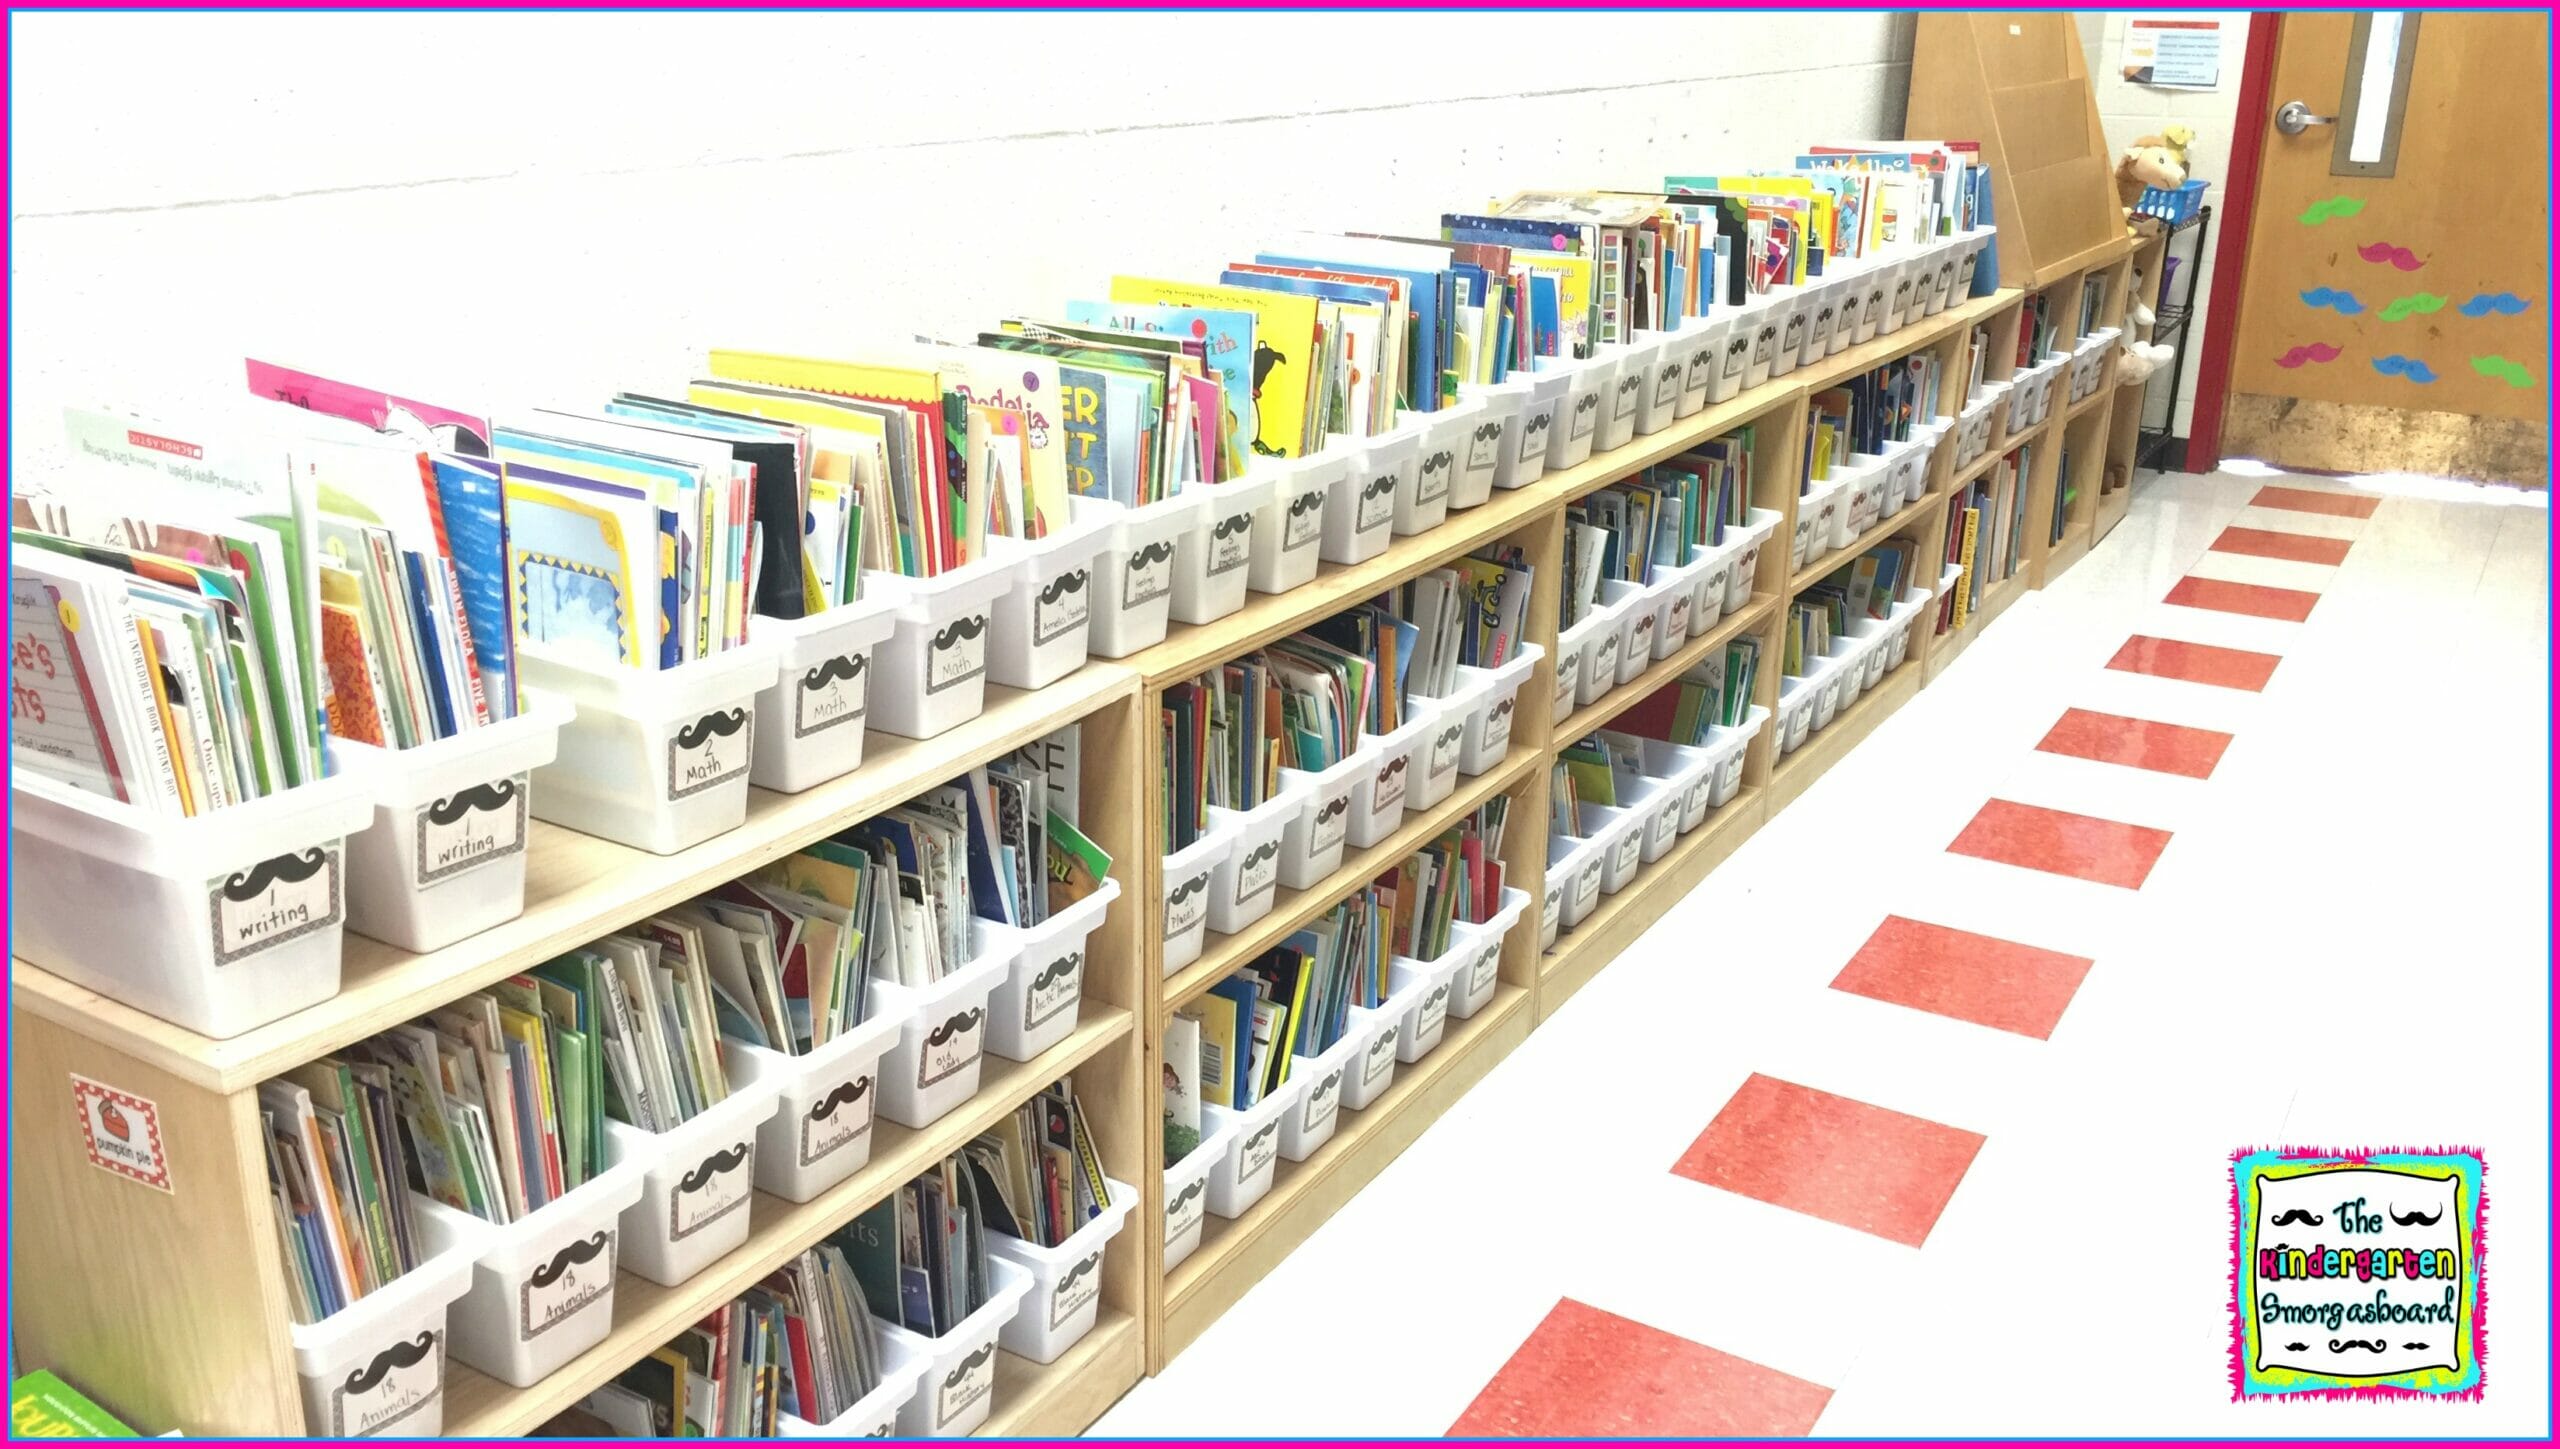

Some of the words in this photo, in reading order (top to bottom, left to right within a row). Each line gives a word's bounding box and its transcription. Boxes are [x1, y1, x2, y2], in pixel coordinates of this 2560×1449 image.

[129, 431, 194, 457] SCHOLASTIC
[1058, 597, 1065, 611] 4
[954, 641, 962, 658] 3
[942, 658, 972, 679] Math
[471, 677, 486, 705] FIVE
[829, 681, 838, 697] 3
[122, 614, 136, 634] THE
[129, 637, 154, 701] INCREDIBLE
[145, 704, 163, 734] BOOK
[154, 733, 172, 773] EATING
[165, 776, 178, 799] BOY
[814, 697, 847, 719] Math
[202, 738, 217, 779] Once
[704, 739, 714, 758] 2
[686, 757, 722, 784] Math
[438, 835, 495, 866] writing
[239, 902, 310, 940] writing
[1170, 908, 1195, 929] Places
[935, 1050, 952, 1067] Old
[829, 1111, 839, 1126] 18
[96, 1137, 135, 1160] pumpkin
[814, 1125, 851, 1154] Animals
[688, 1193, 732, 1227] Animals
[561, 1269, 576, 1292] 18
[544, 1282, 597, 1321] Animals
[381, 1376, 397, 1399] 18
[359, 1388, 422, 1431] Animals
